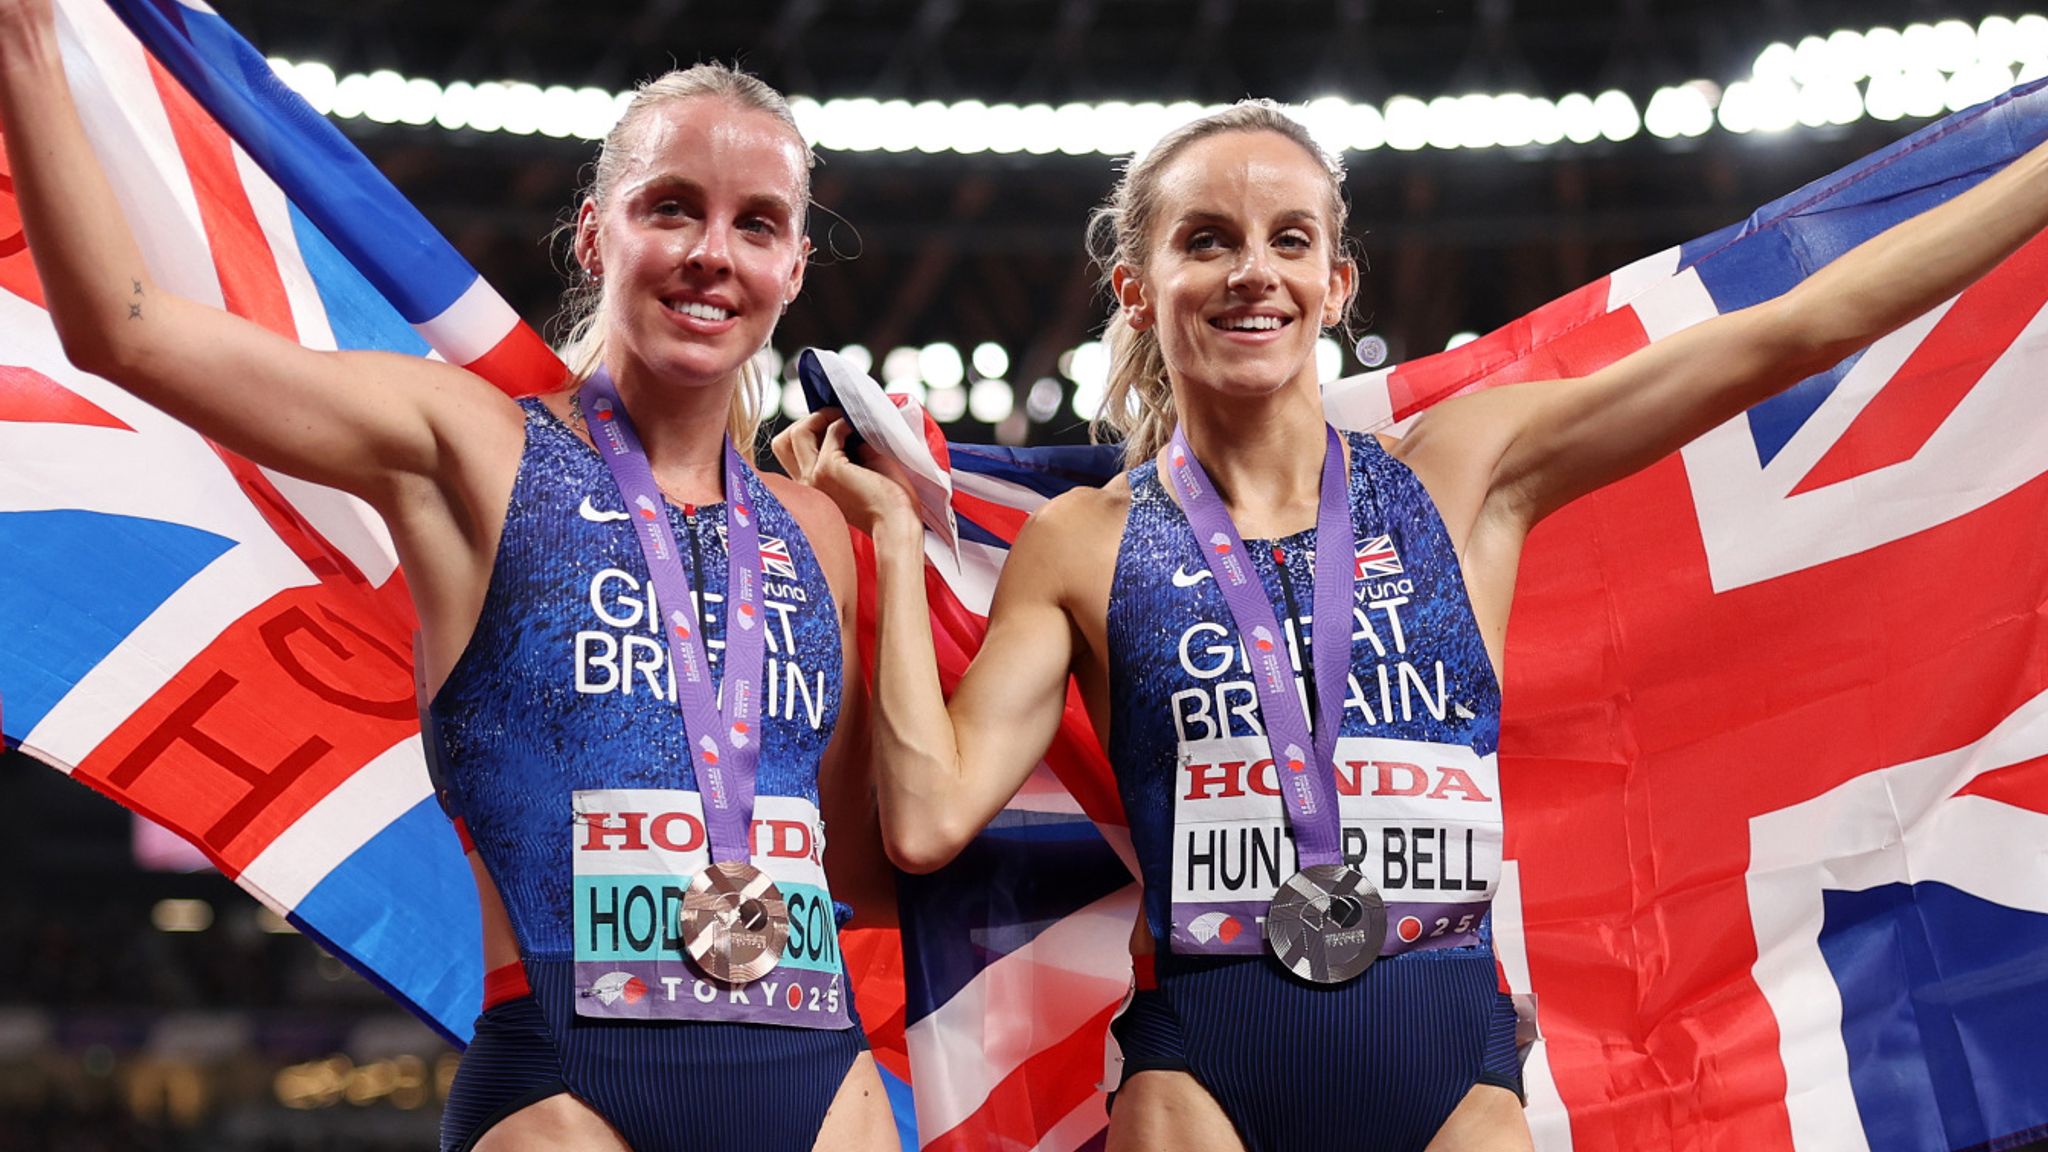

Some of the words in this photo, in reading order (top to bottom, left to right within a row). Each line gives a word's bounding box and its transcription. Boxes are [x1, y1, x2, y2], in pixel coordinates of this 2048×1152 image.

[1183, 759, 1493, 802] HONDA
[1188, 826, 1368, 891] HUNR
[1382, 827, 1488, 892] BELL
[590, 885, 836, 964] HODSON
